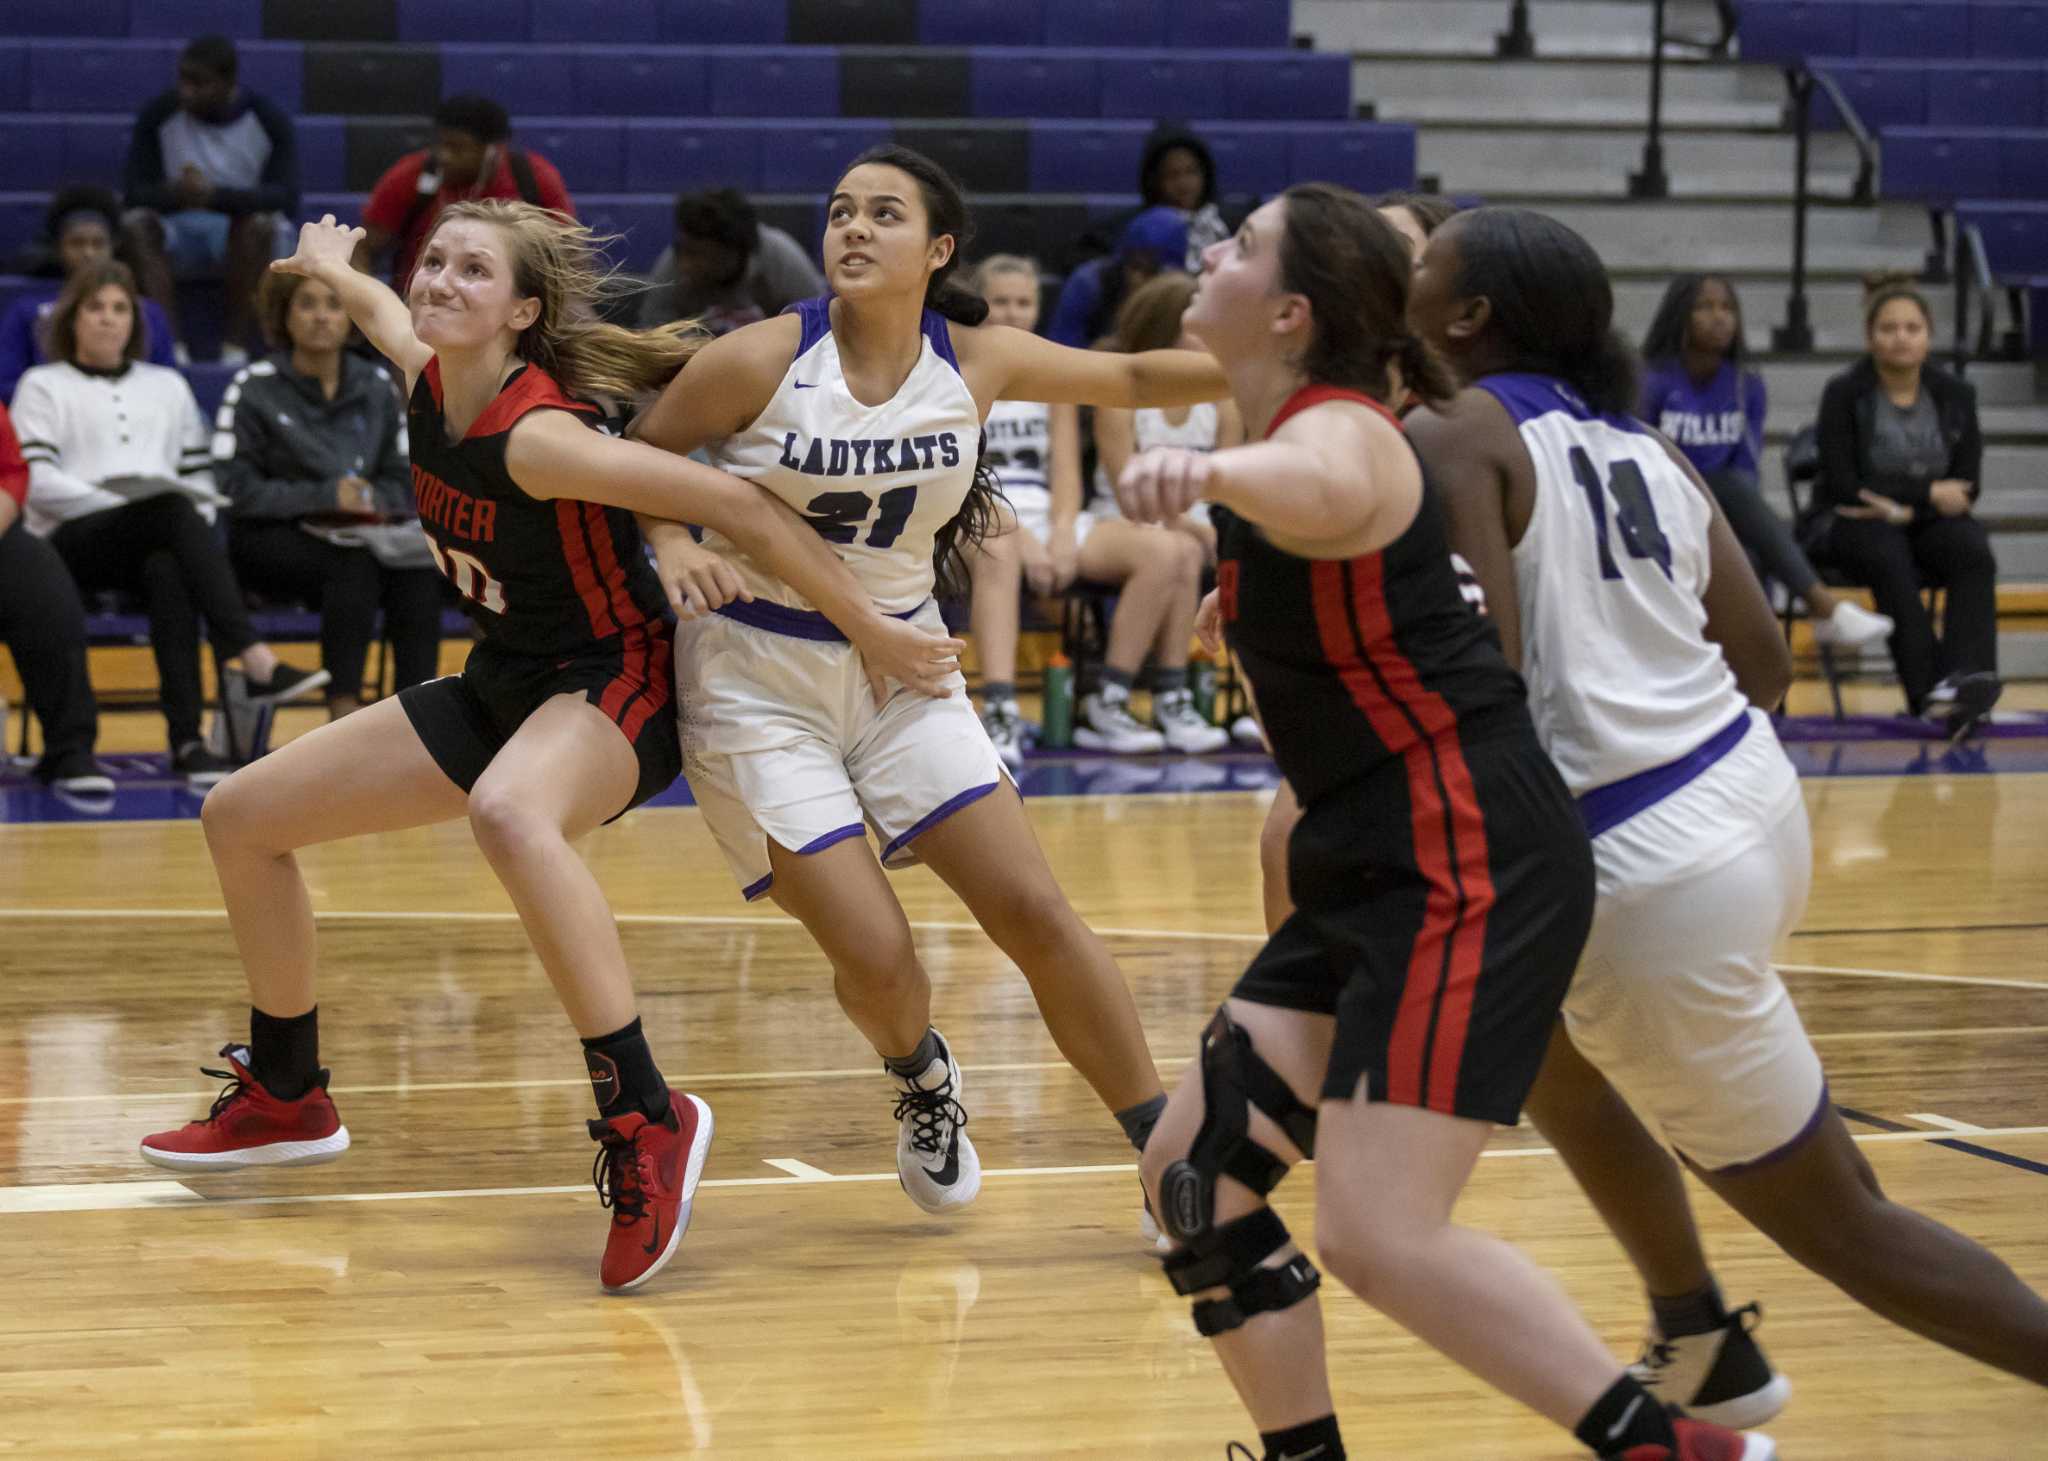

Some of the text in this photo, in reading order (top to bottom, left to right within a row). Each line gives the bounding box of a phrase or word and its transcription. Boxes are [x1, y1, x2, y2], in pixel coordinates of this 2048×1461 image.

[779, 432, 960, 476] LADYKATS
[804, 485, 918, 548] 21
[1569, 445, 1675, 582] 14
